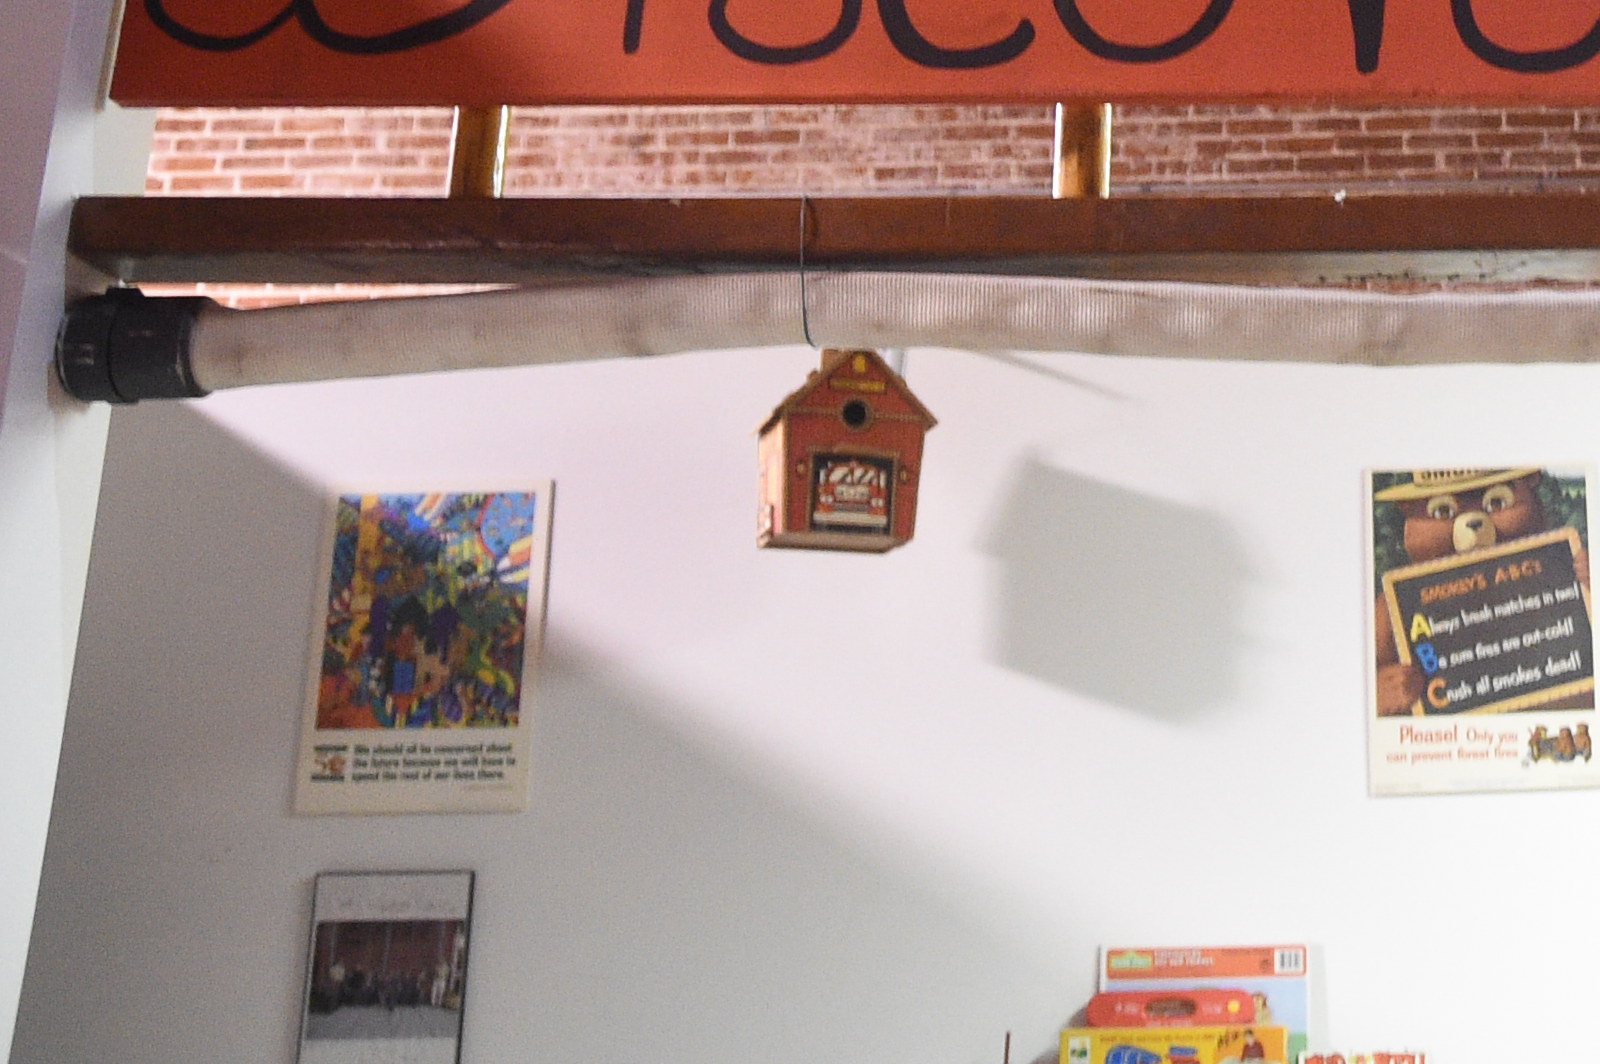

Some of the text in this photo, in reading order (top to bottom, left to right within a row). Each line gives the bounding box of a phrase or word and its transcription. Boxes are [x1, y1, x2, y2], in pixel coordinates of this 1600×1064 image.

[1460, 603, 1493, 626] break
[1494, 594, 1541, 617] matches
[1475, 642, 1500, 660] fires
[1502, 636, 1520, 652] are
[1476, 674, 1490, 695] all
[1492, 664, 1542, 692] smokes
